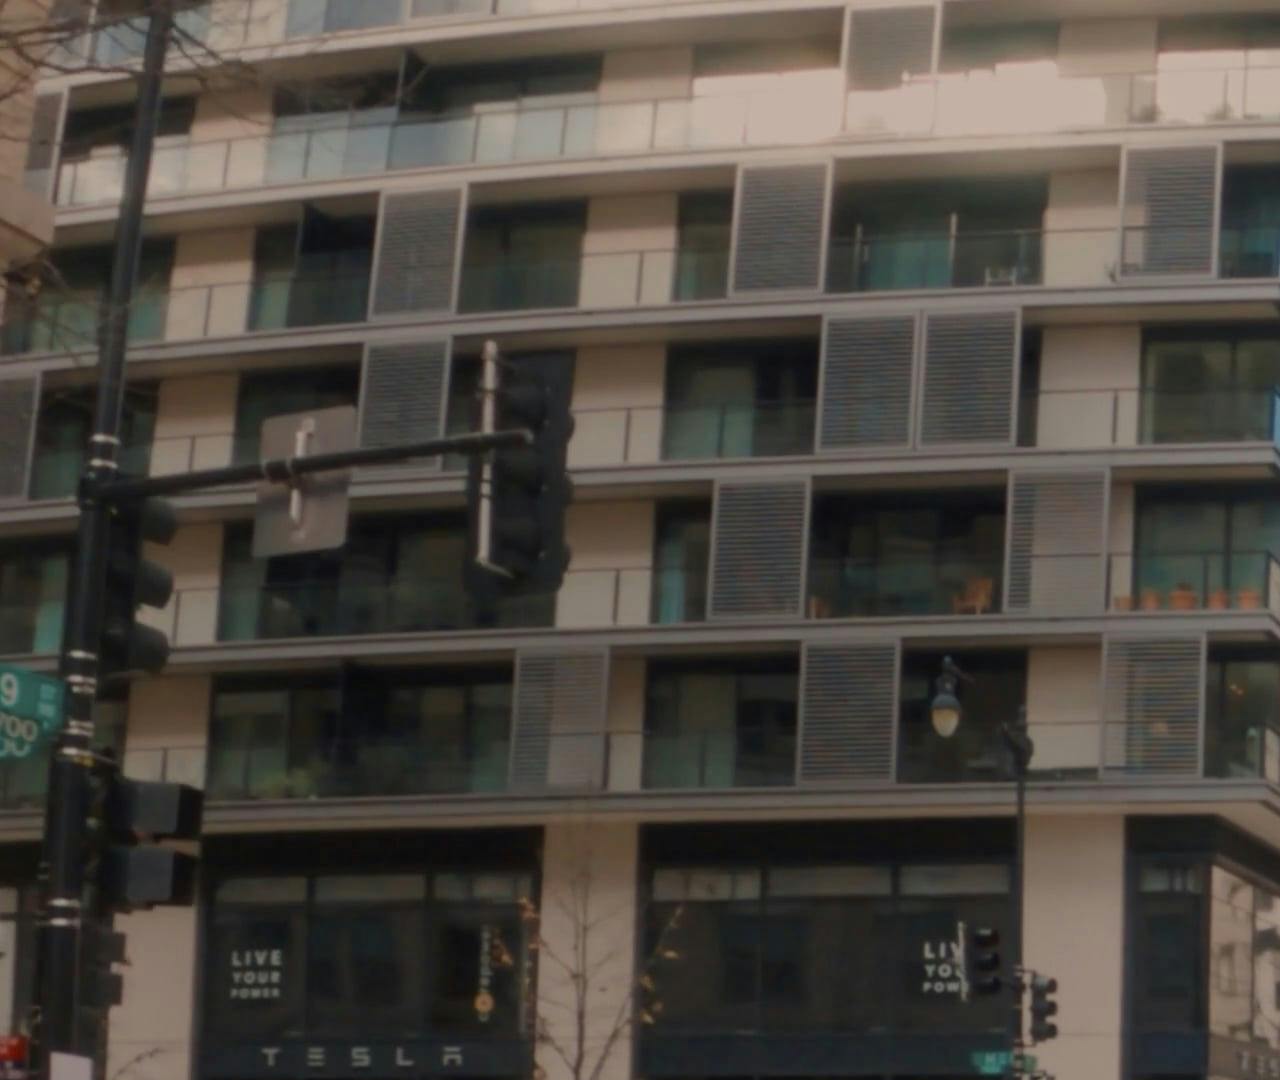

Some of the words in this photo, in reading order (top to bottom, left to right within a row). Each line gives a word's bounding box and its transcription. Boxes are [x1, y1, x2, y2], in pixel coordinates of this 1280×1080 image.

[0, 672, 19, 707] 9
[231, 949, 284, 967] LIVE
[923, 941, 965, 960] LIV
[232, 970, 281, 985] YOUR
[261, 1046, 463, 1068] TESLA
